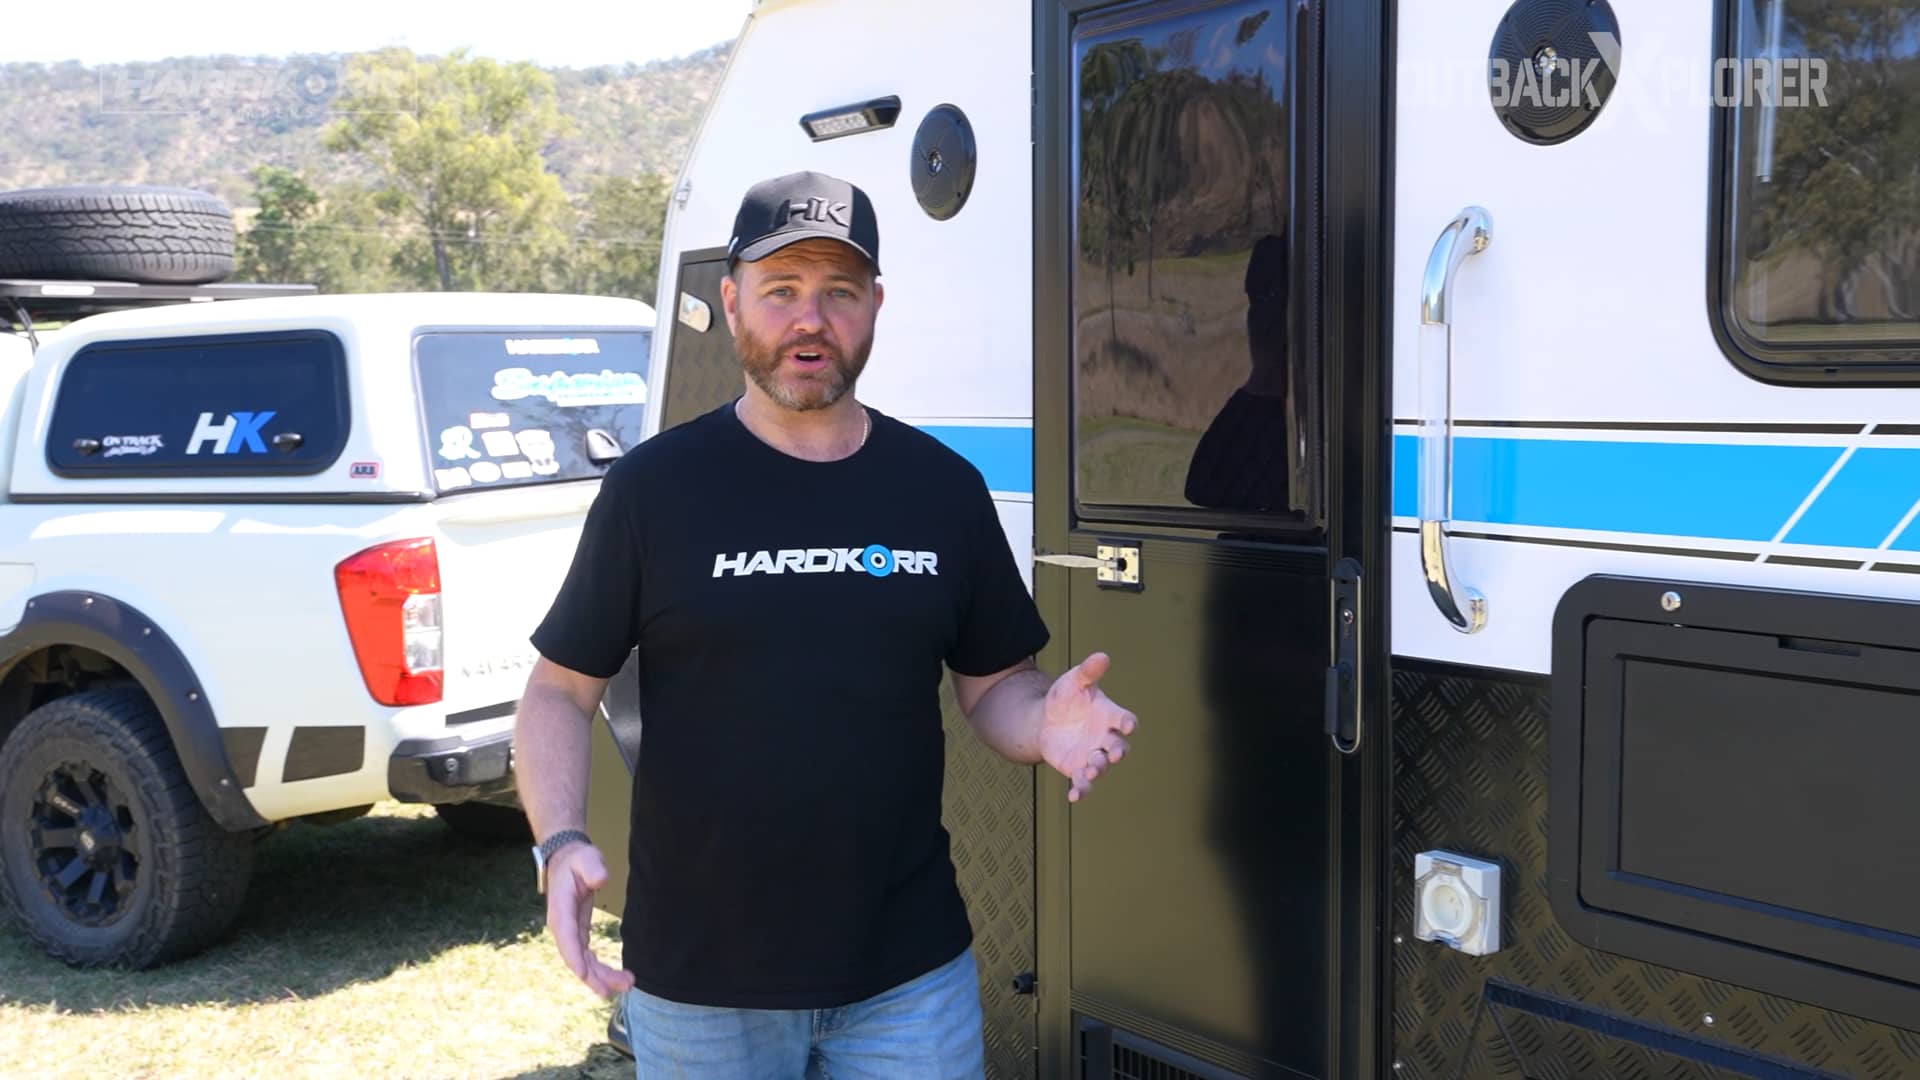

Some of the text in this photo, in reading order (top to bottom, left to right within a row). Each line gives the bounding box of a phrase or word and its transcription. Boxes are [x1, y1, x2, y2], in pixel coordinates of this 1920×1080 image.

[775, 196, 849, 228] HK
[123, 434, 164, 448] TRACK
[186, 411, 276, 455] HK
[712, 544, 938, 577] HARDKORR
